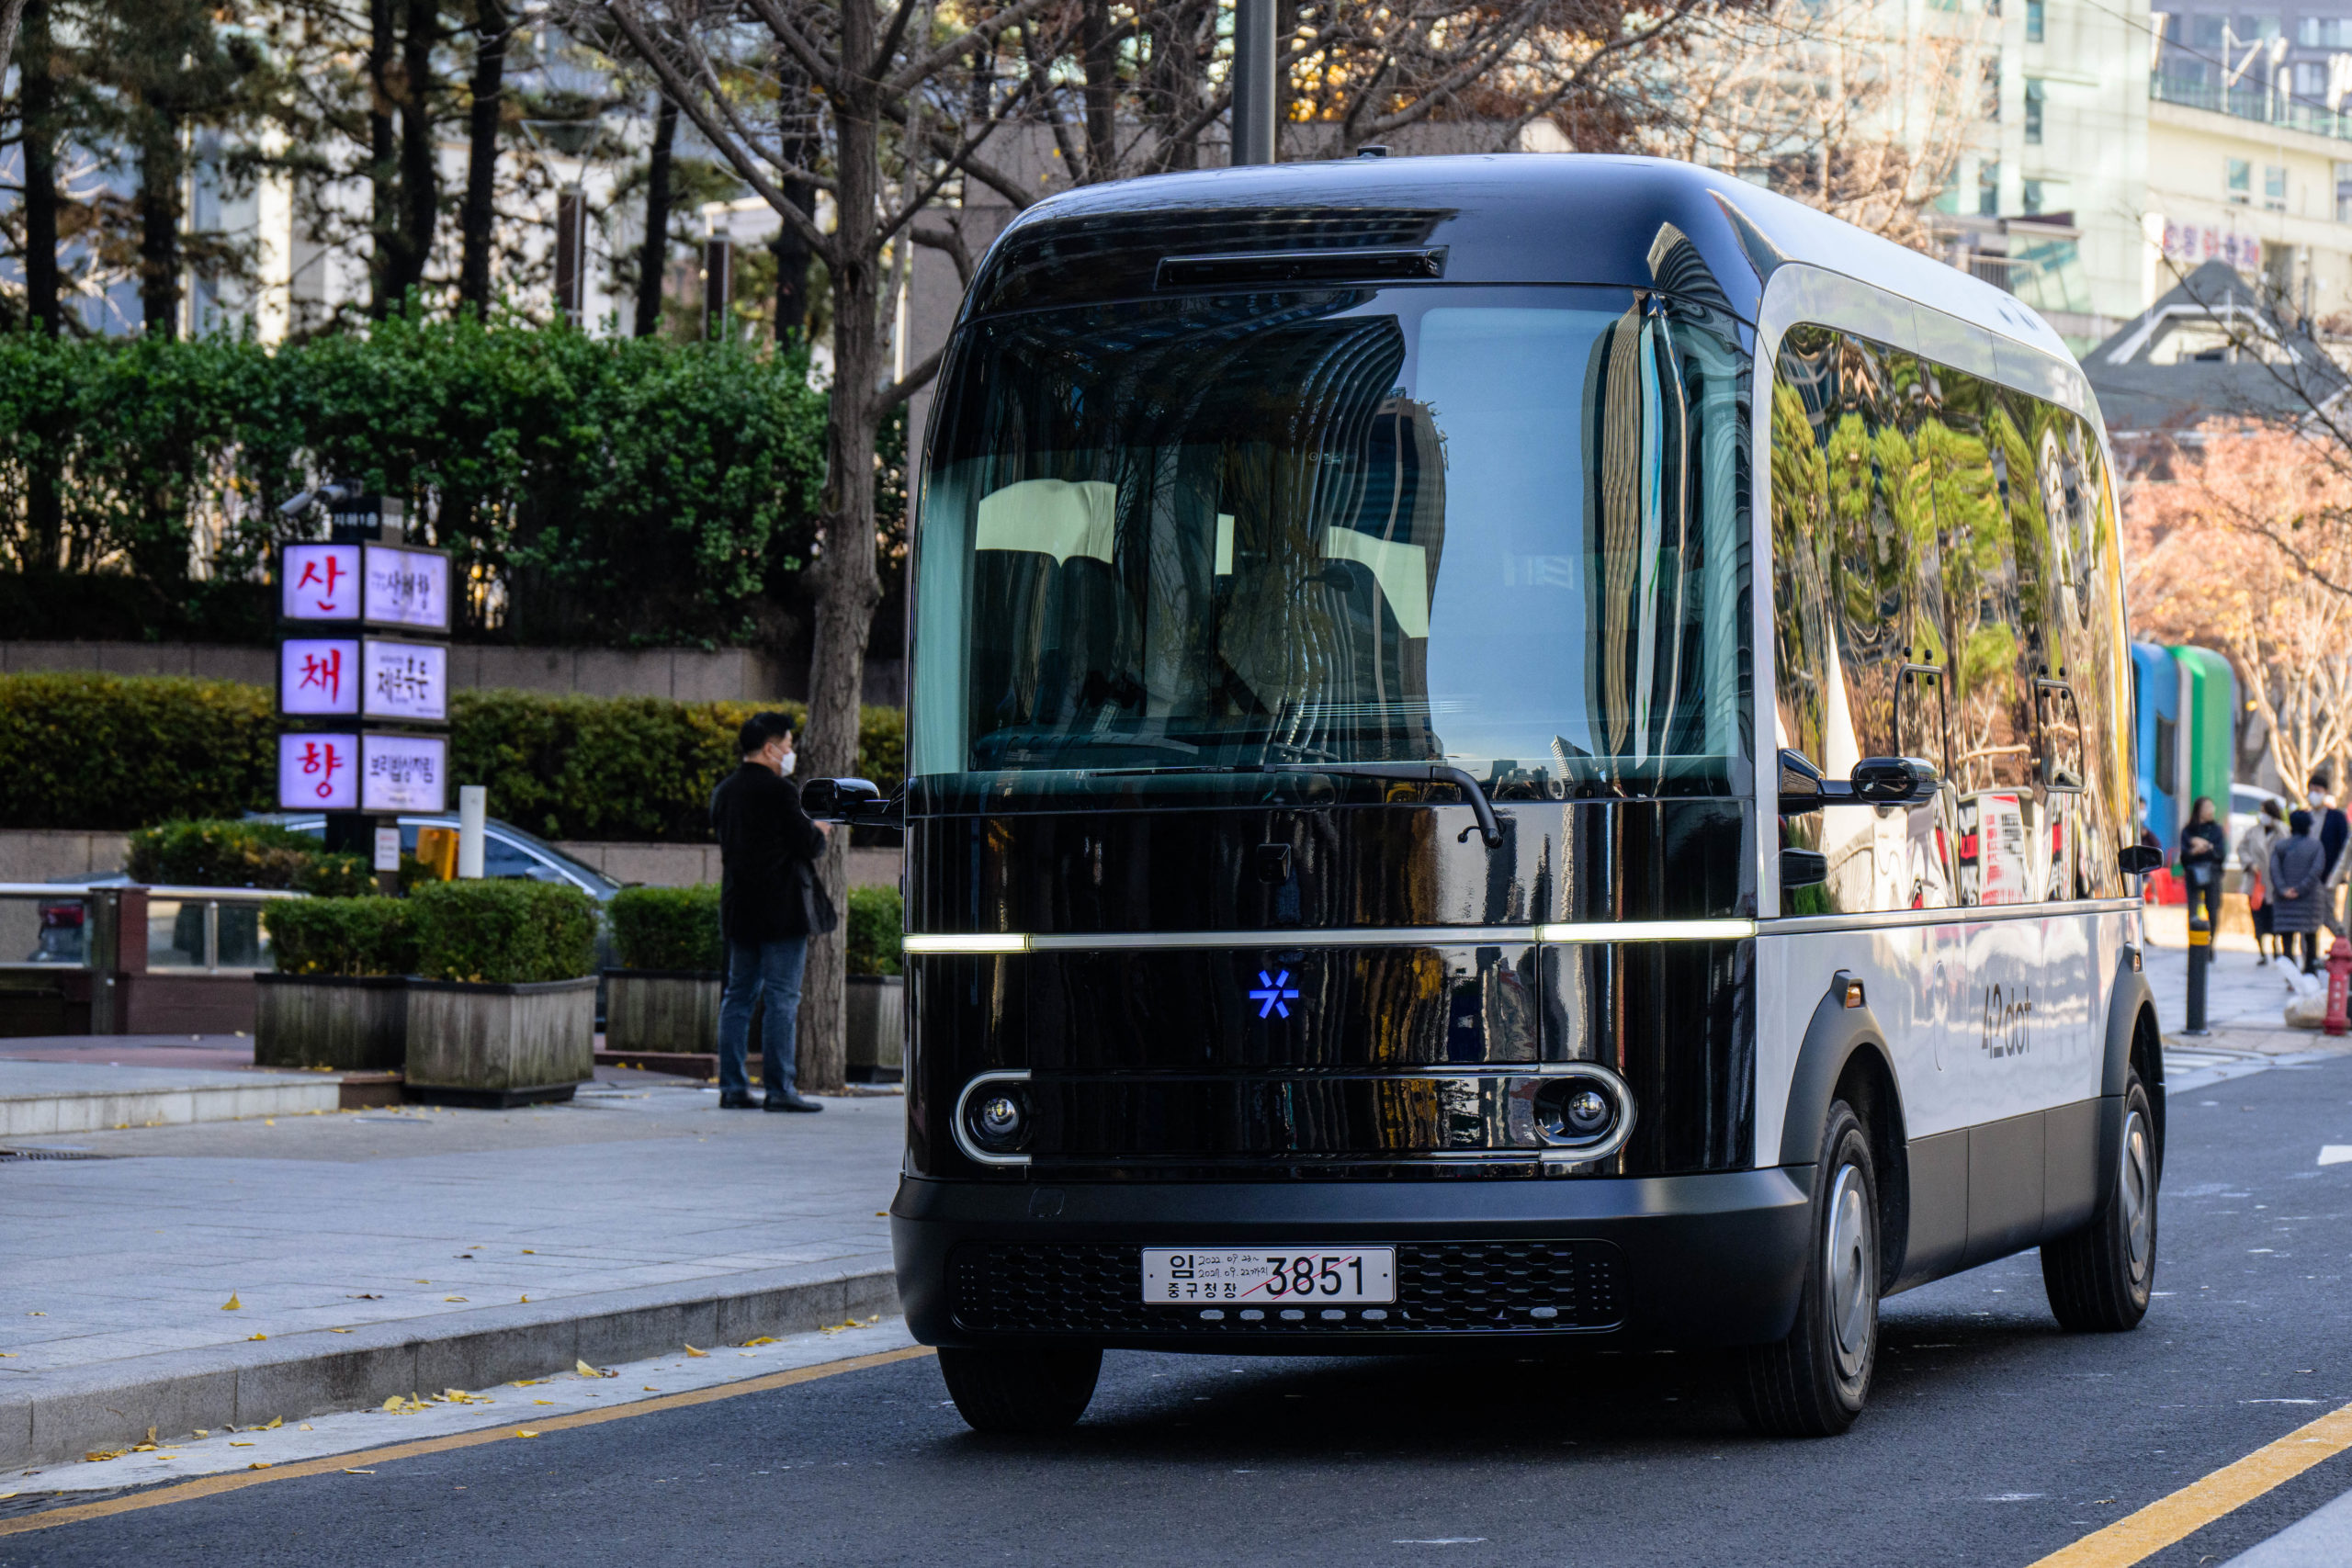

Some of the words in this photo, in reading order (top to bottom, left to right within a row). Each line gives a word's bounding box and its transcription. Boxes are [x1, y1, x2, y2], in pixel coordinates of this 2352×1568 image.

[1982, 983, 2031, 1059] 42dot
[1168, 1282, 1237, 1299] 중구청장
[1170, 1254, 1194, 1279] 임
[1264, 1256, 1363, 1296] 3851
